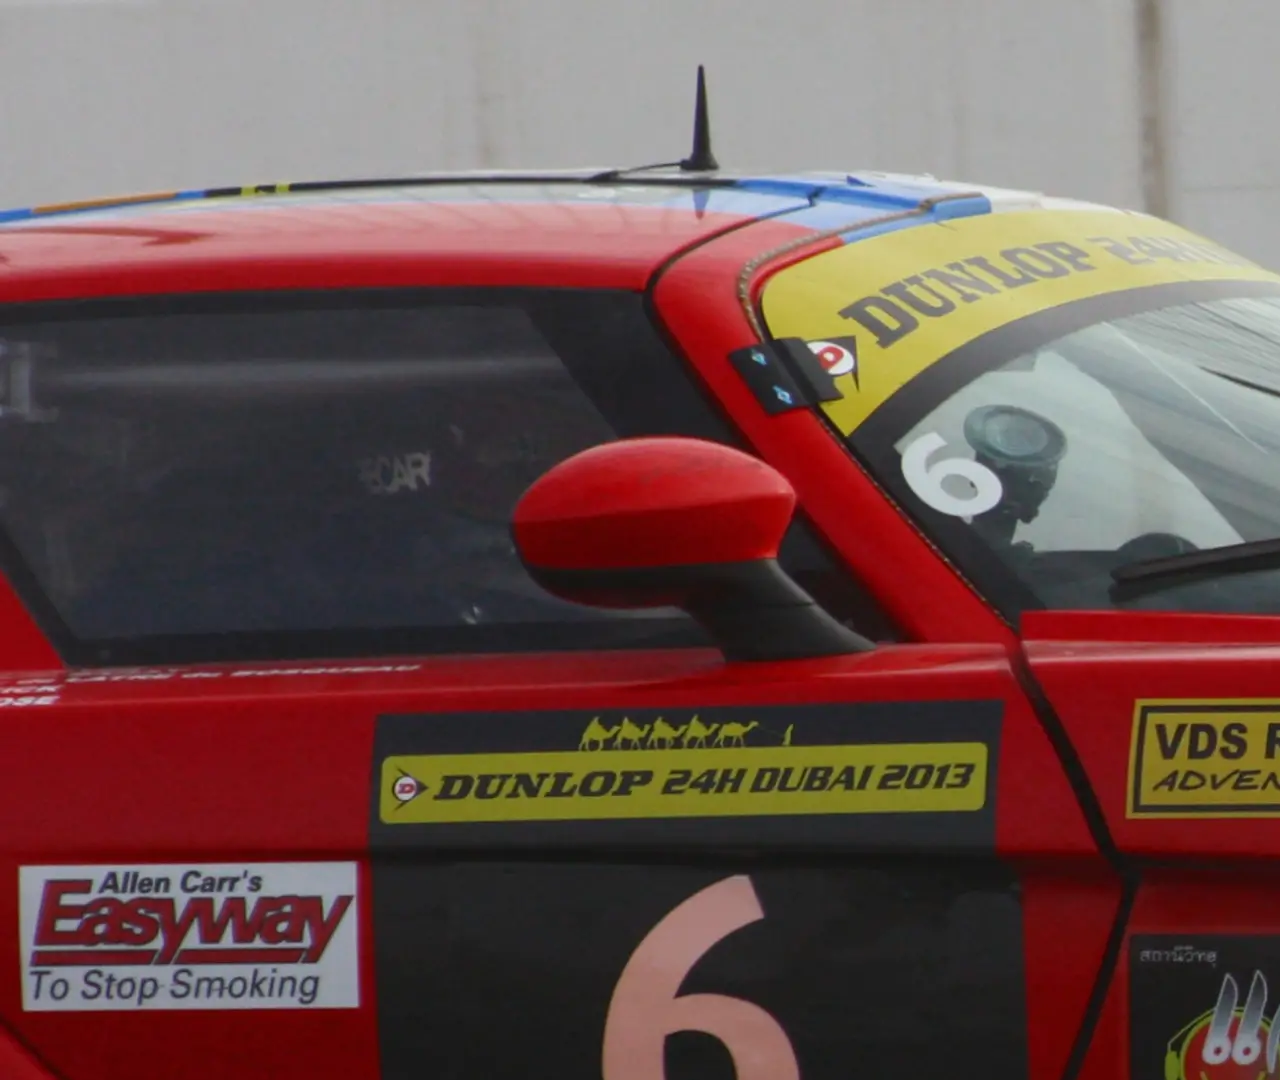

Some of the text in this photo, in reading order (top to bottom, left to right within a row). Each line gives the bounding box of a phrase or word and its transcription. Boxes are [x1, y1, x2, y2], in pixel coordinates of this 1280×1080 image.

[837, 240, 1097, 349] DUNLOP
[901, 431, 1003, 518] 6
[1155, 722, 1249, 760] VDS
[434, 771, 654, 800] DUNLOP
[661, 768, 748, 795] 24H
[750, 765, 875, 793] DUBAI
[877, 763, 977, 790] 2013
[98, 870, 263, 894] Allen Carr's
[34, 878, 354, 964] Easyway
[30, 968, 321, 1005] To Stop Smoking
